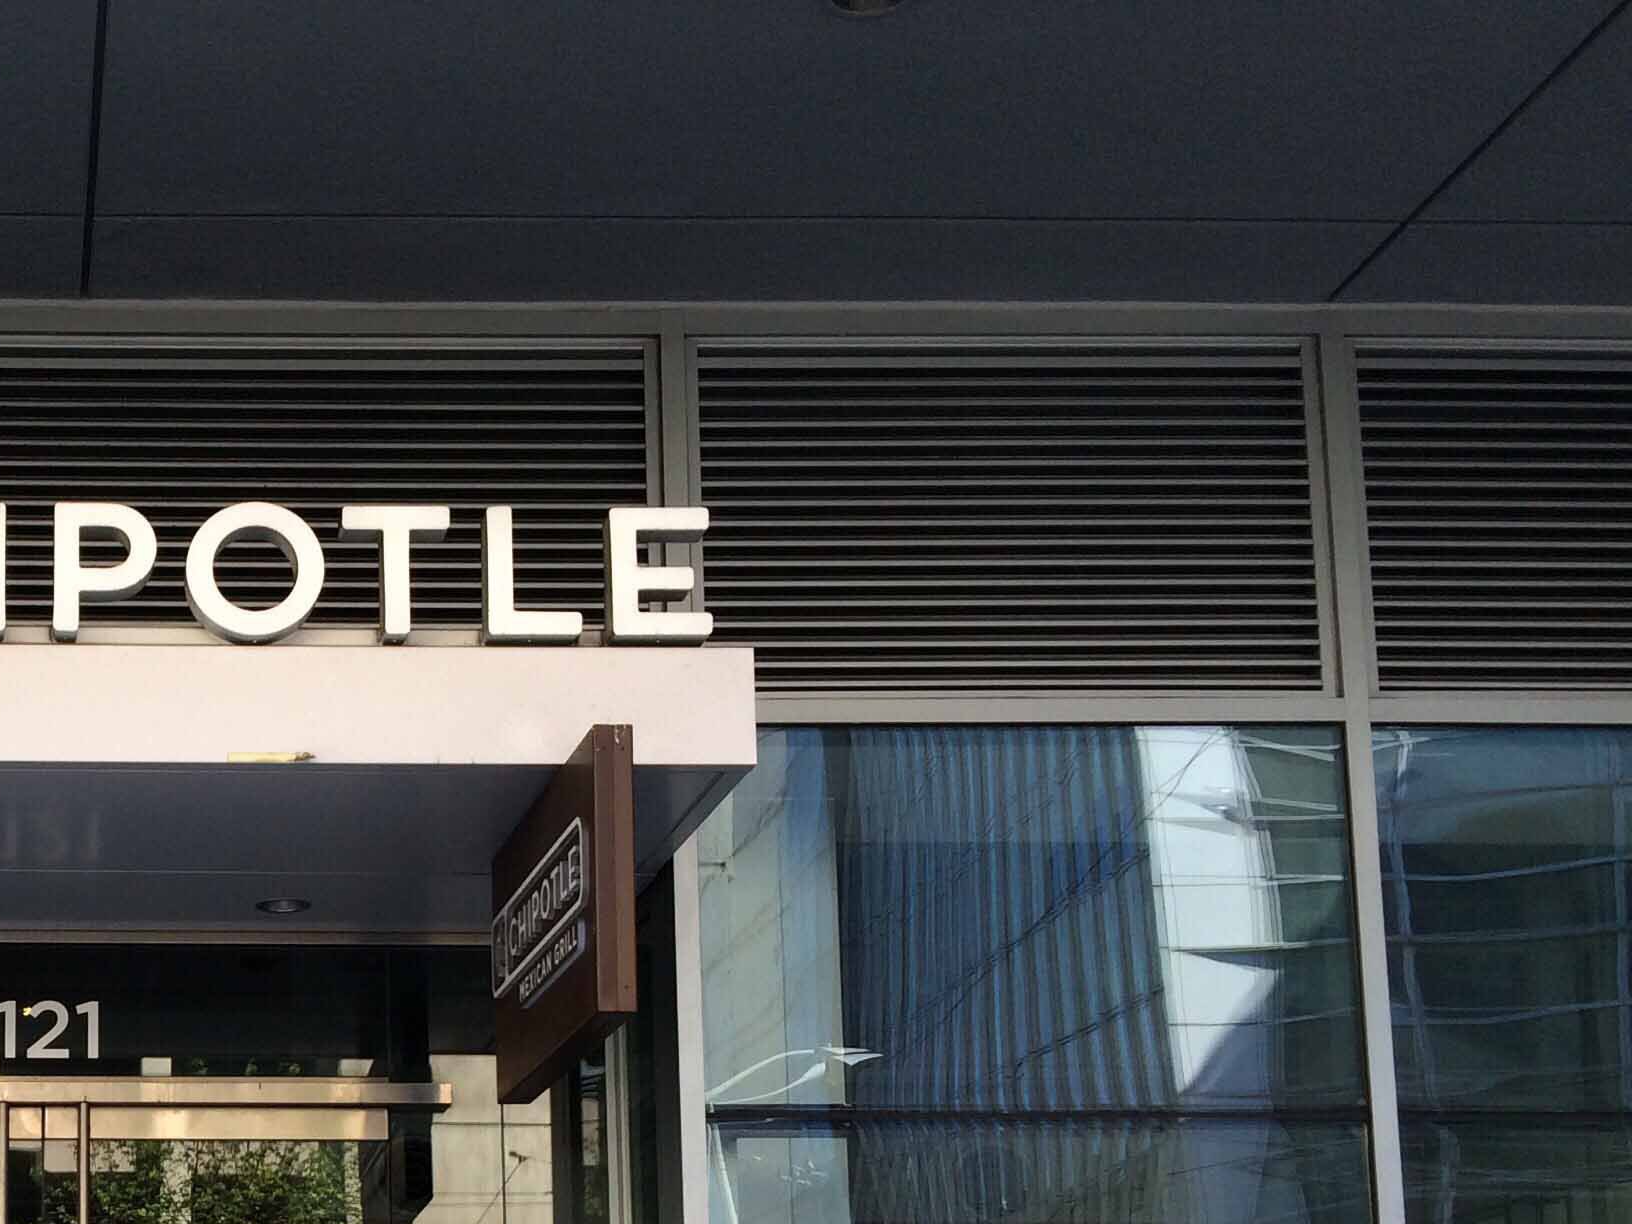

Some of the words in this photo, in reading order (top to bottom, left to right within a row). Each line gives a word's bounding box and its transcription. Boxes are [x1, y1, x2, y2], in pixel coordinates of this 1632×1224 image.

[509, 845, 579, 957] CHIPOTLE
[519, 952, 553, 1001] MEXICAN
[554, 924, 578, 966] GRILL
